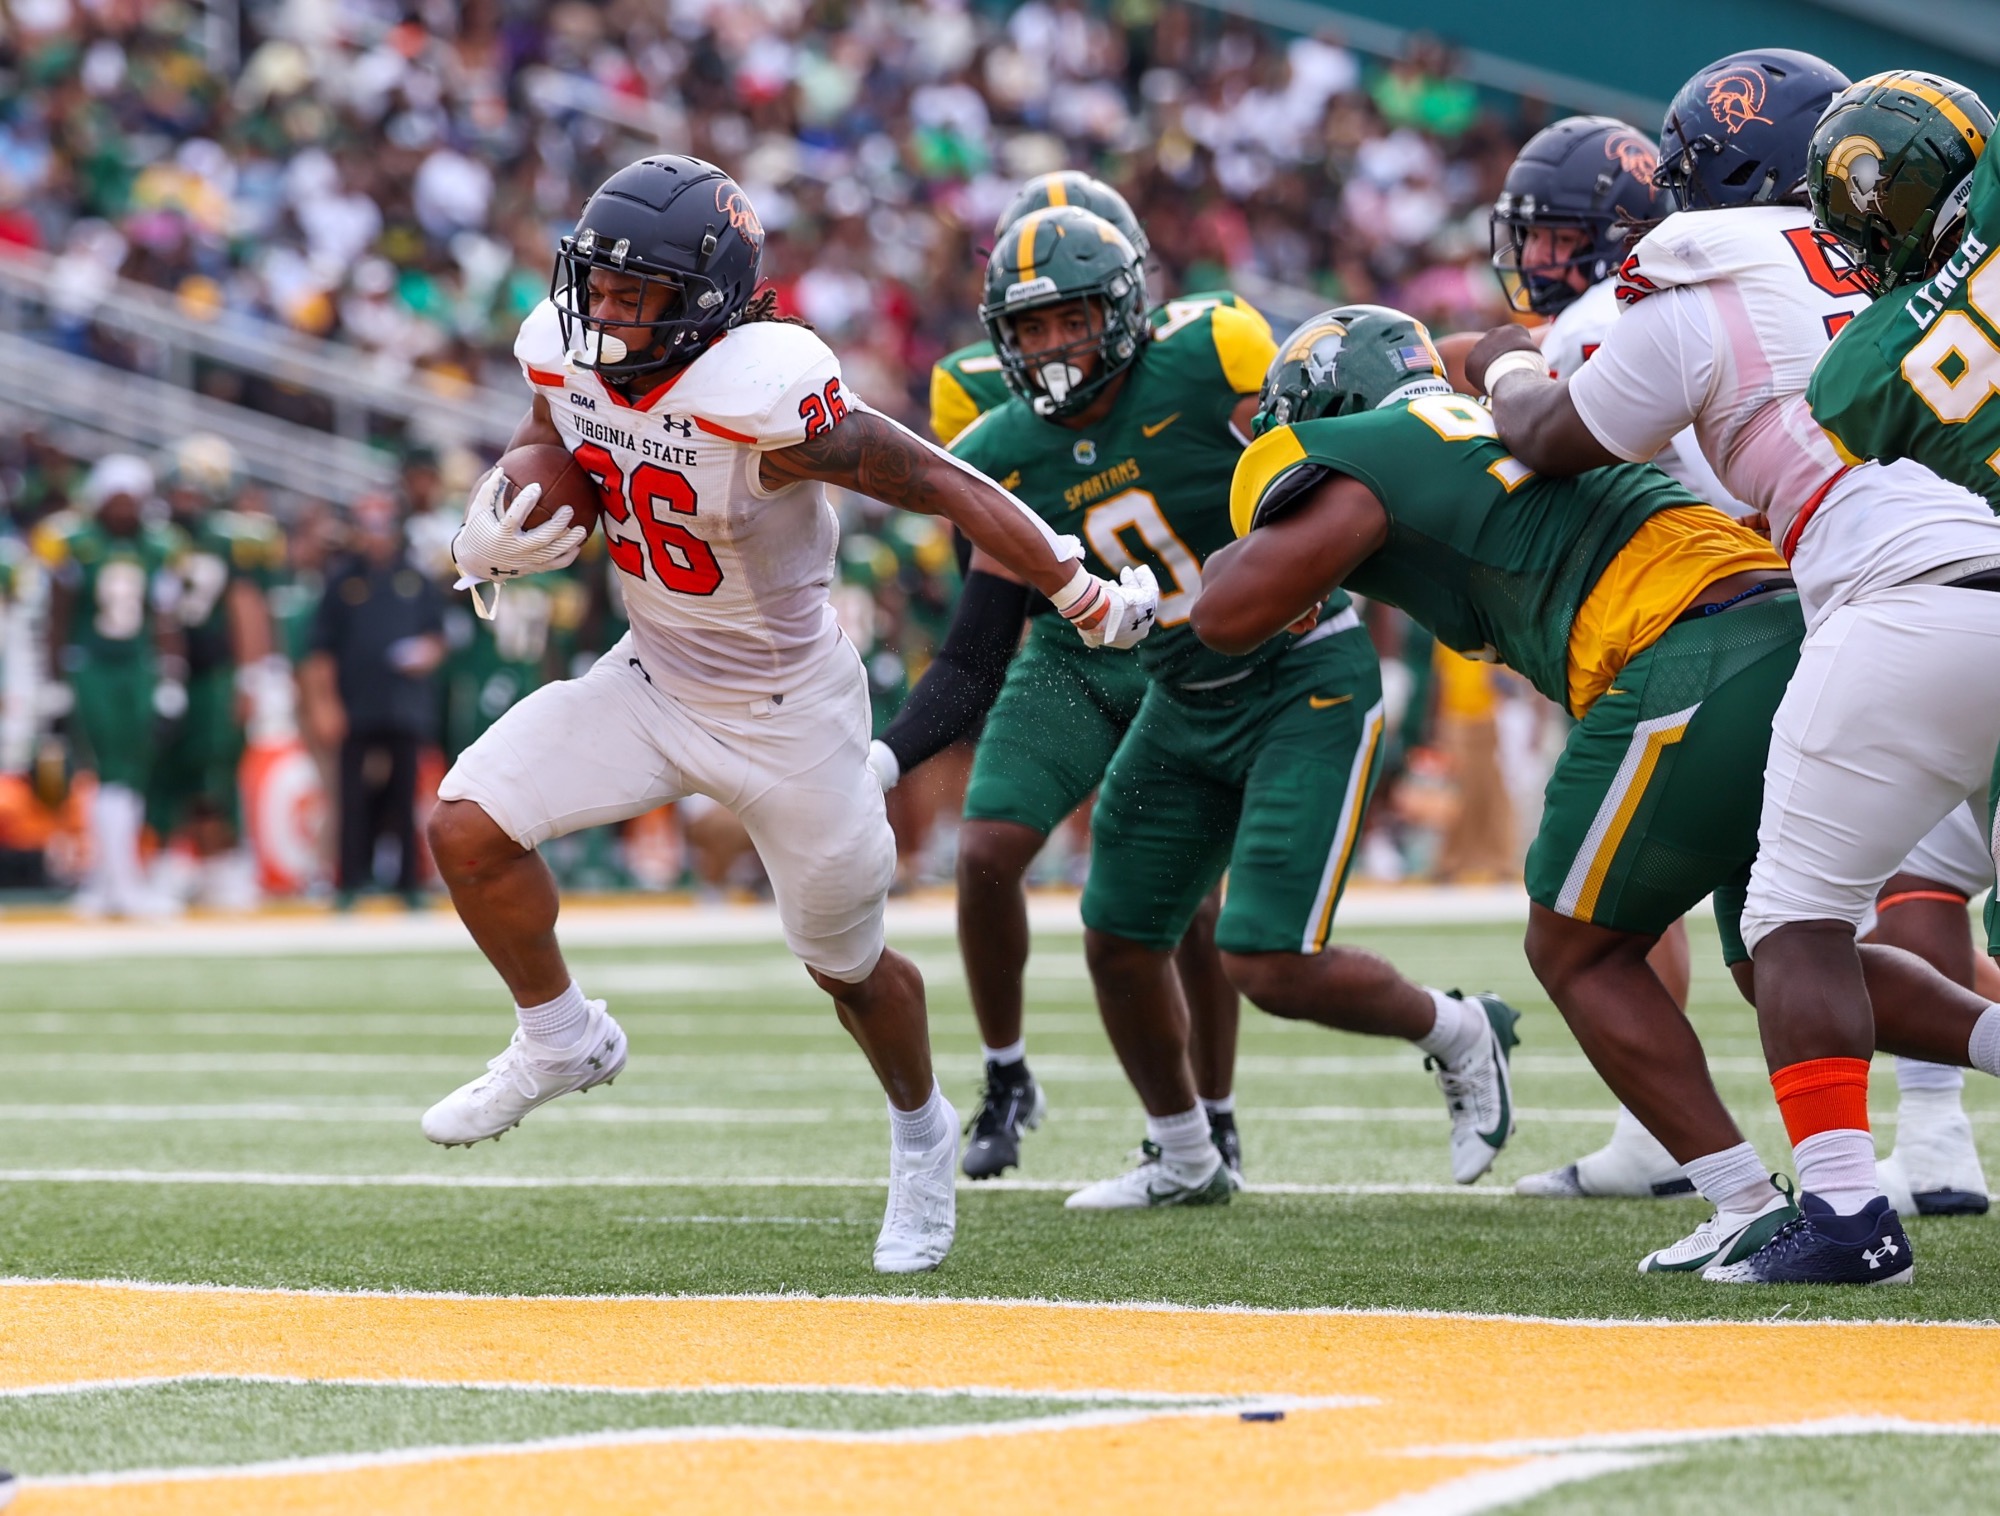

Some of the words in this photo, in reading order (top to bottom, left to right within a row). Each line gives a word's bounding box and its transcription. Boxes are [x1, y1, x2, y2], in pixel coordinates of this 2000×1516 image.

[1905, 228, 1988, 330] LYNCH
[570, 392, 596, 411] CIAA
[798, 376, 848, 441] 26
[573, 414, 636, 452] VIRGINIA
[642, 438, 697, 467] STATE
[1064, 457, 1141, 511] SPARTANS
[572, 441, 724, 596] 26
